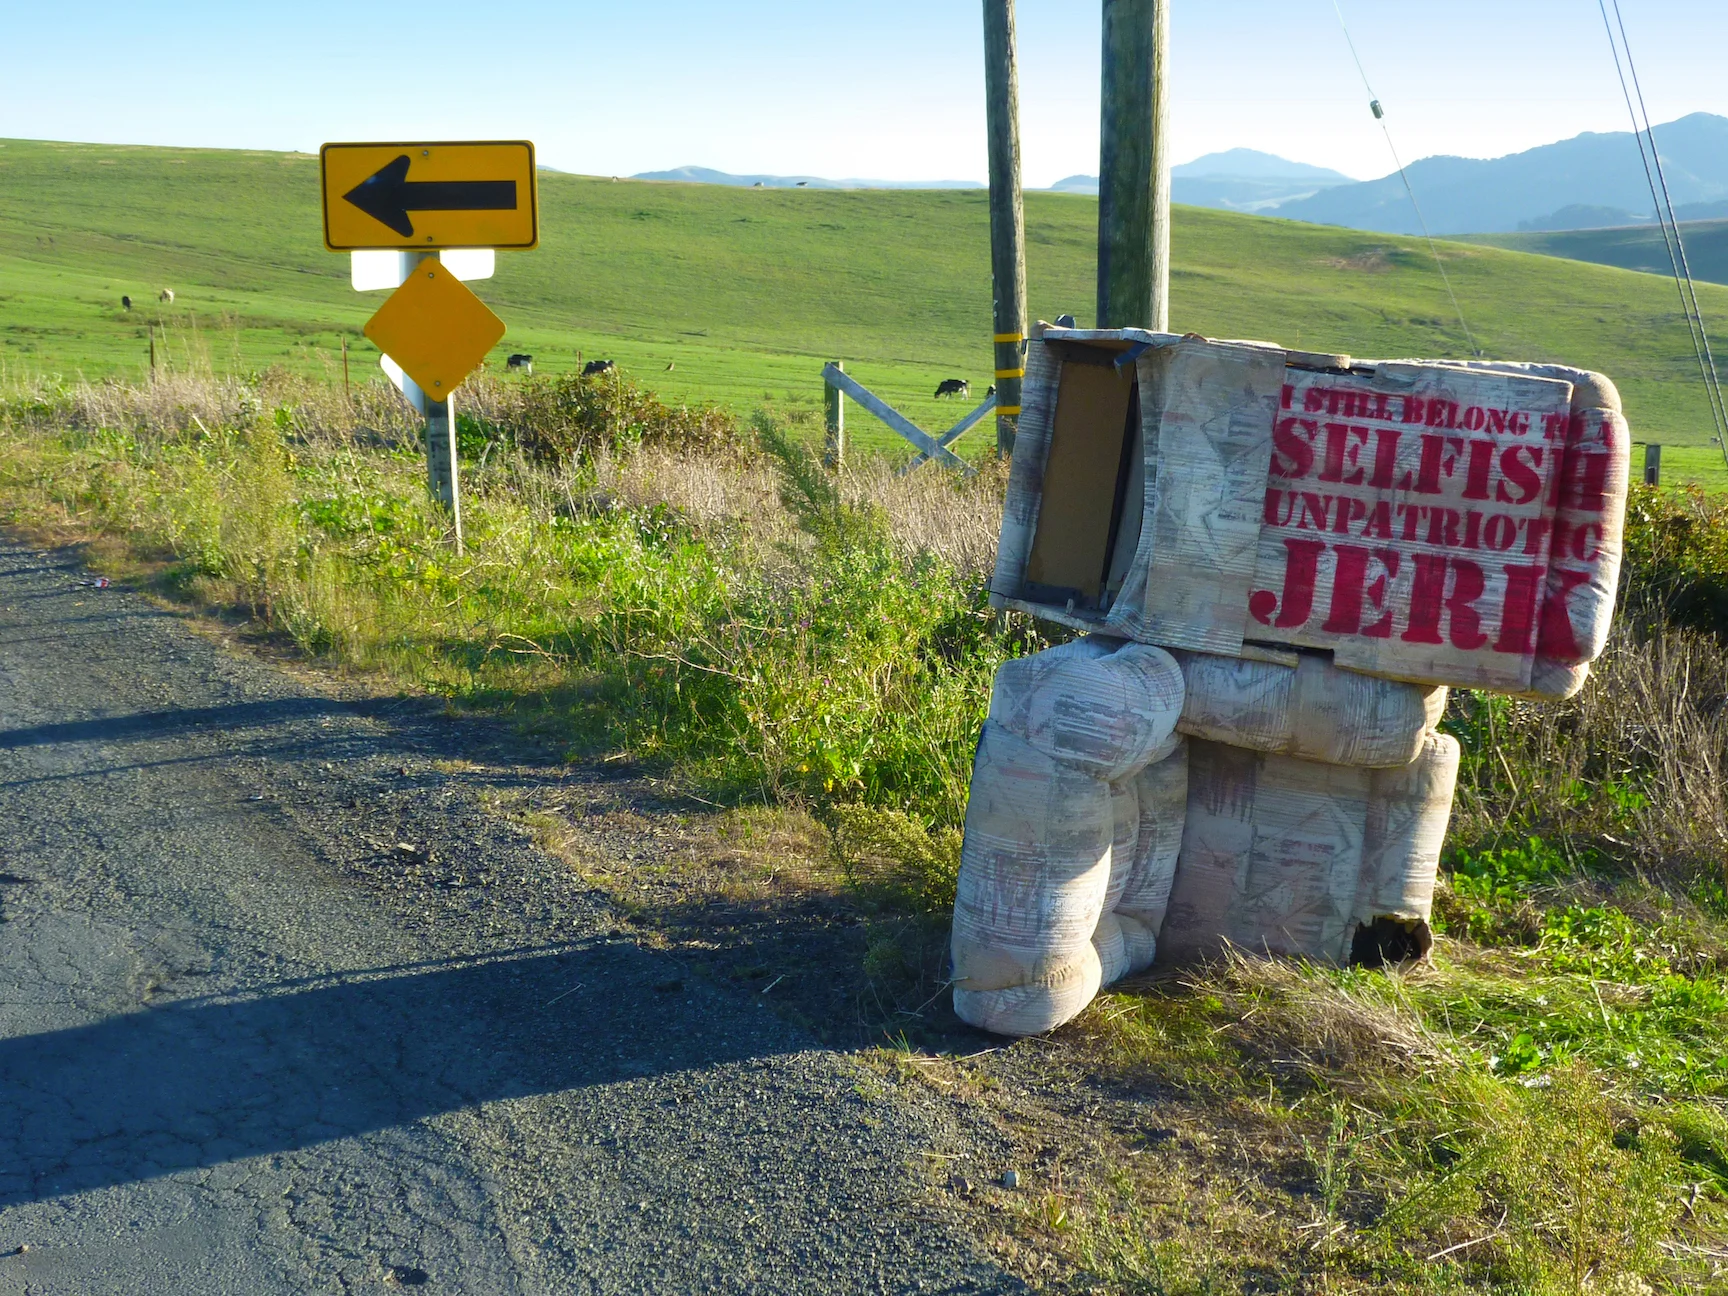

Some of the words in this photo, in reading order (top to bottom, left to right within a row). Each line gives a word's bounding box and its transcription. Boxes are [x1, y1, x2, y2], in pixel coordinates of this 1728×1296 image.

[1281, 384, 1294, 409] I
[1303, 387, 1393, 421] STILL
[1401, 396, 1529, 436] BELONG
[1541, 411, 1585, 443] TO
[1271, 417, 1612, 513] SELFISH
[1264, 488, 1602, 562] UNPATRIOTIC
[1249, 538, 1591, 661] JERK
